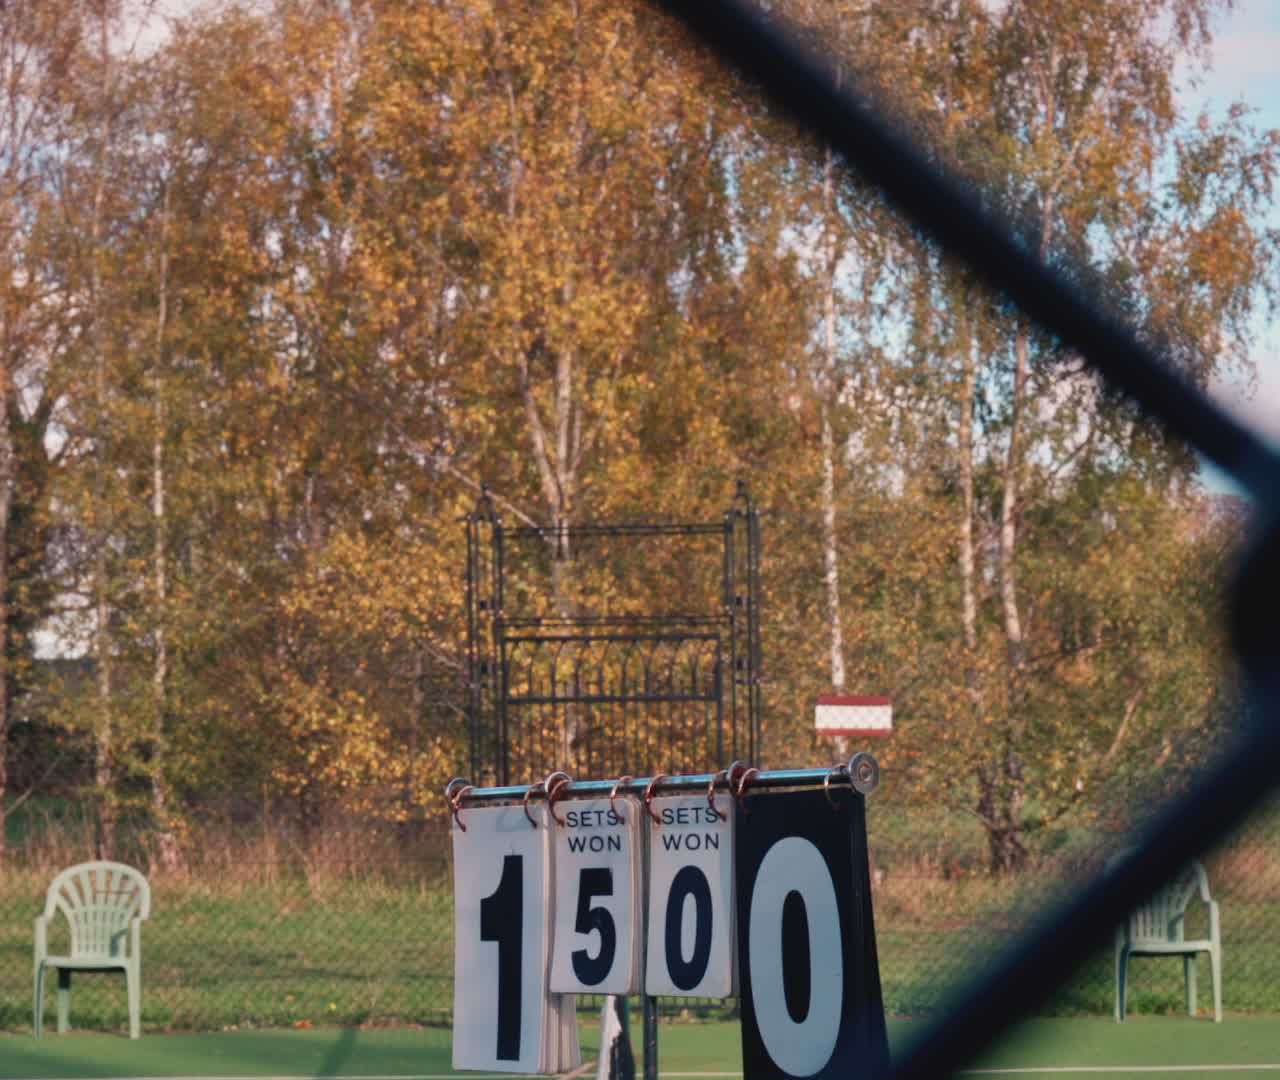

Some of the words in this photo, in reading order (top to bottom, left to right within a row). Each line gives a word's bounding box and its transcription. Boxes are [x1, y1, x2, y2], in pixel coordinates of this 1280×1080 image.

[566, 809, 619, 828] SETS
[568, 836, 622, 853] WON
[662, 806, 718, 826] SETS
[662, 833, 720, 851] WON
[480, 854, 524, 1062] 1
[571, 866, 616, 986] 5
[664, 864, 713, 991] 0
[749, 836, 843, 1077] 0
